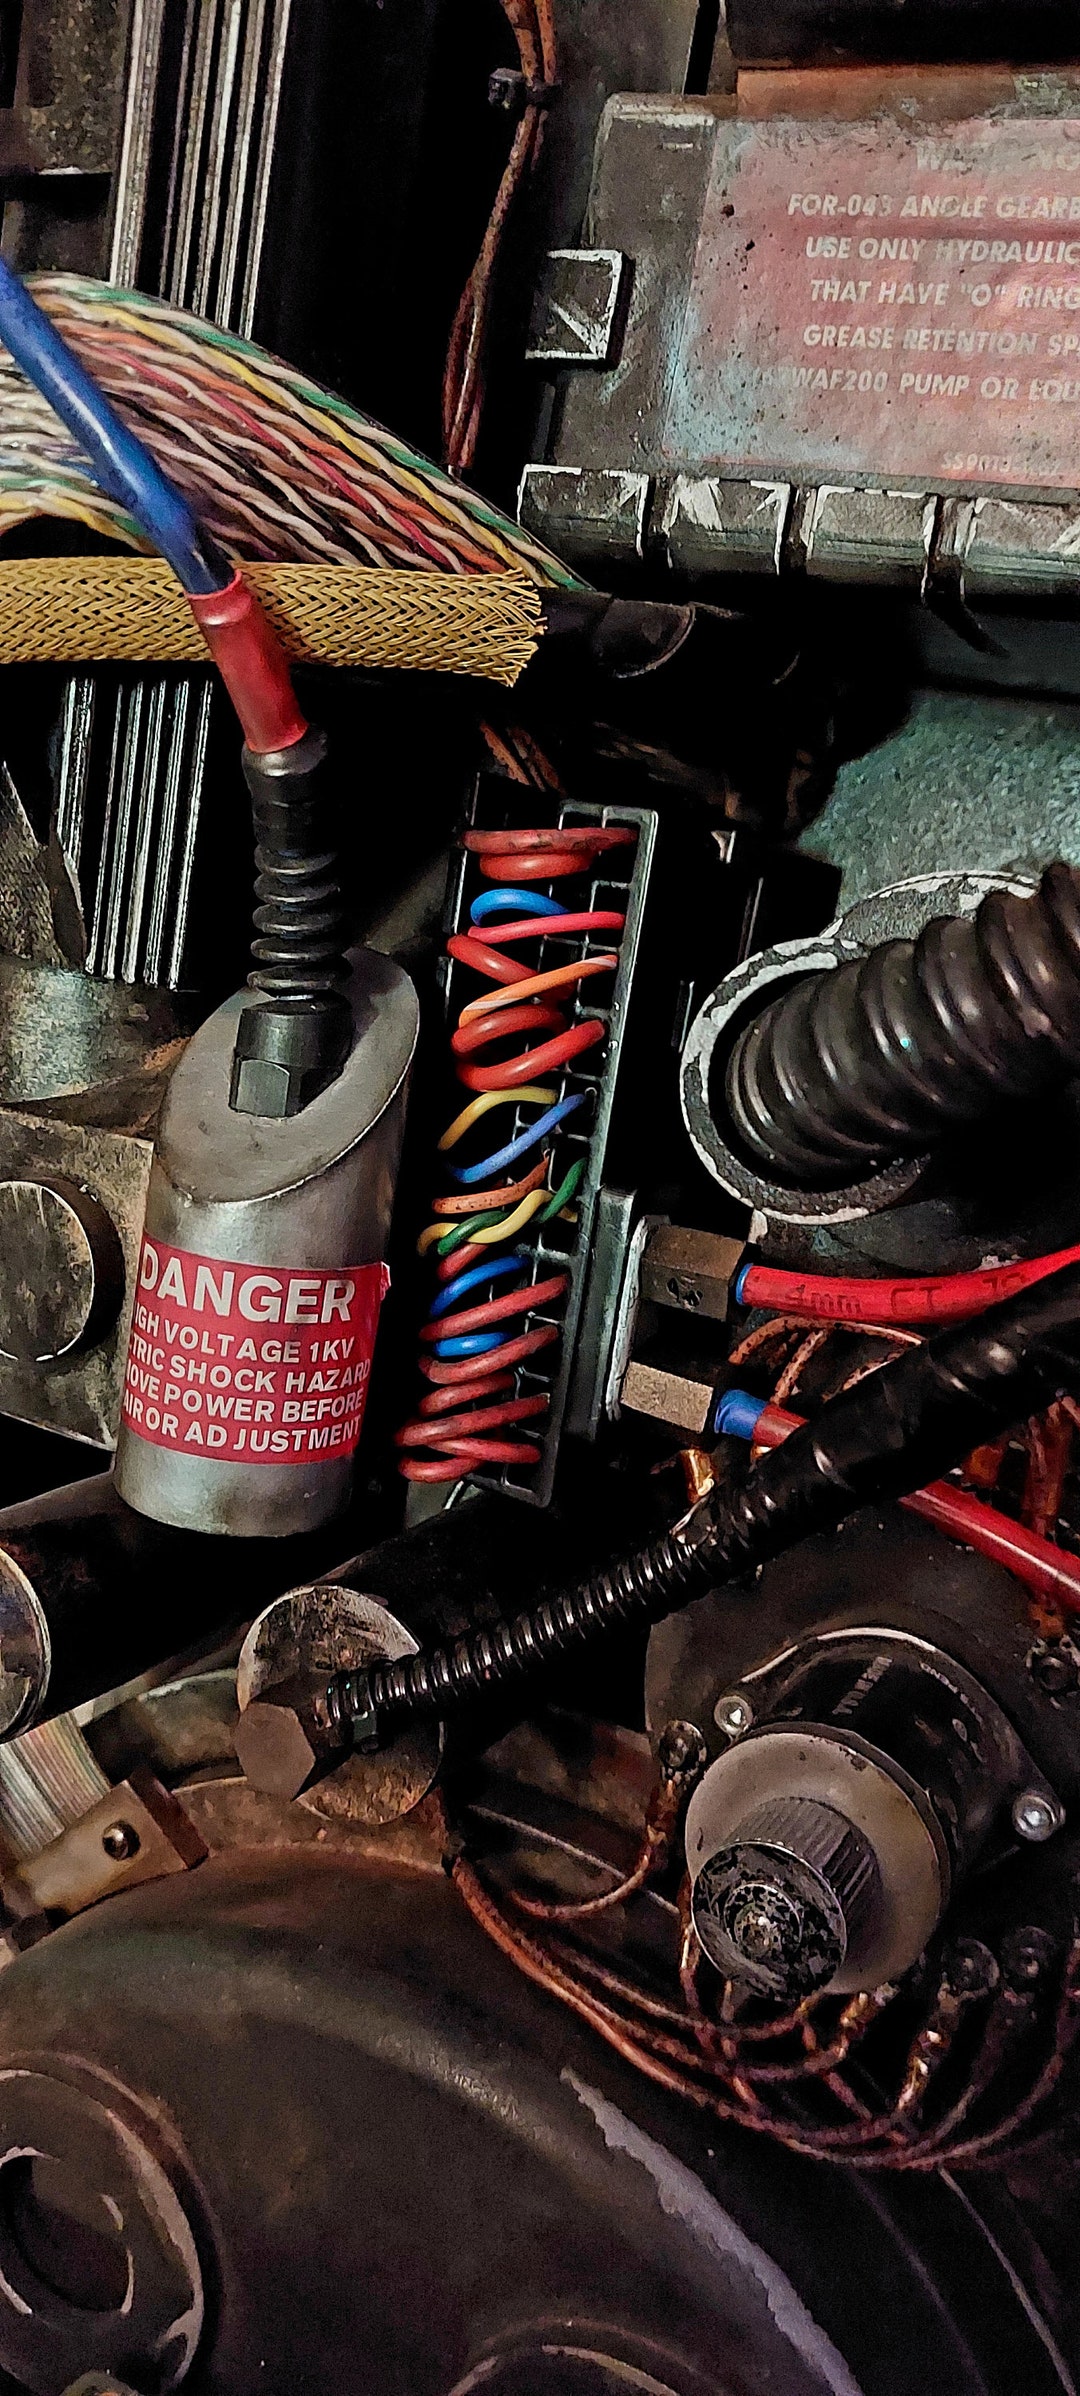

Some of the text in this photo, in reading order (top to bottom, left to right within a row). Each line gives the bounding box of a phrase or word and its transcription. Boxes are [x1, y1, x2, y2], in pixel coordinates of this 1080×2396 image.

[900, 195, 988, 219] ANGLE
[806, 237, 851, 259] USE
[859, 238, 926, 263] ONLY
[811, 280, 871, 302] THAT
[878, 283, 949, 306] HAVE
[803, 325, 894, 349] GREASE
[903, 329, 1040, 354] RETENTION
[900, 372, 970, 397] PUMP
[980, 376, 1019, 400] OR
[140, 1243, 355, 1324] DANGER
[310, 1336, 355, 1363] 1KV
[168, 1355, 275, 1394] SHOCK
[284, 1358, 371, 1394] HAZARD
[163, 1382, 275, 1423] POWER
[281, 1387, 364, 1423] BEFORE
[145, 1406, 178, 1439] OR
